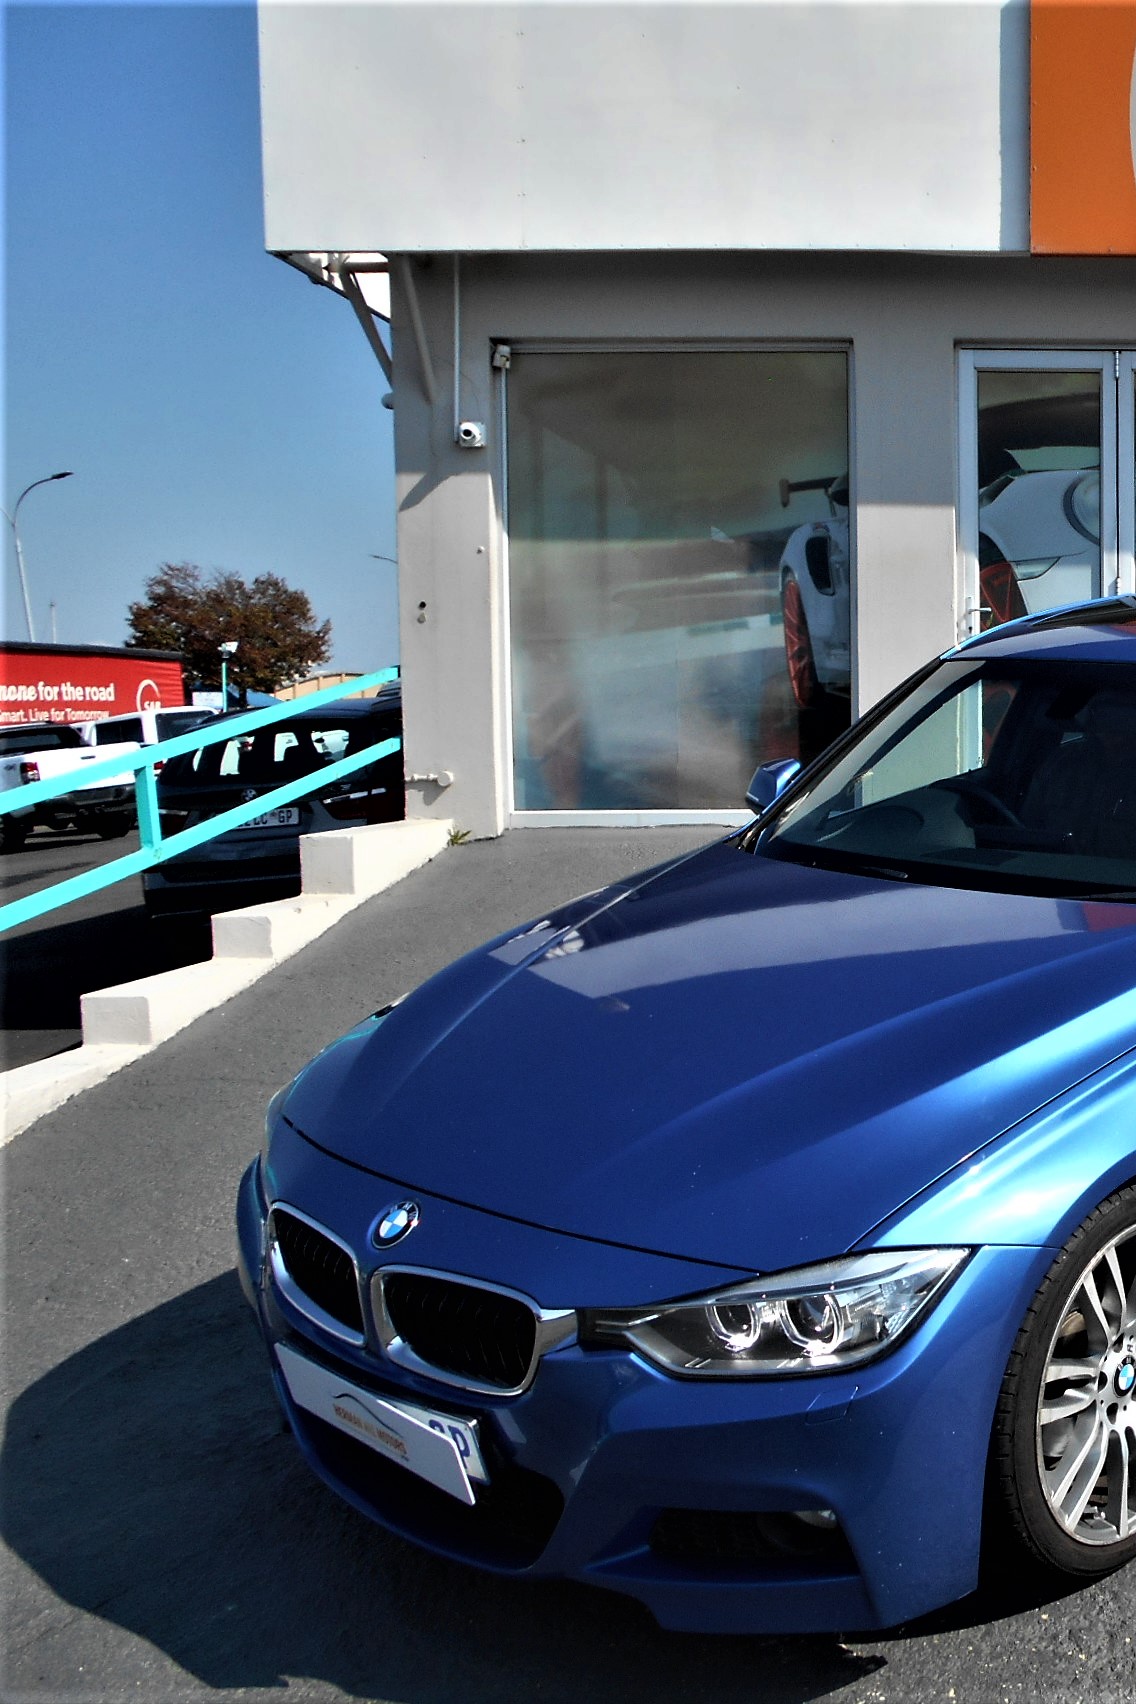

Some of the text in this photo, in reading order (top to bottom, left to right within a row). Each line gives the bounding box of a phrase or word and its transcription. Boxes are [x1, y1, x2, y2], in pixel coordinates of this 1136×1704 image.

[37, 681, 59, 701] for
[61, 681, 83, 701] the
[84, 682, 115, 702] road
[28, 708, 49, 722] Live
[50, 707, 65, 721] for
[278, 809, 293, 824] GP
